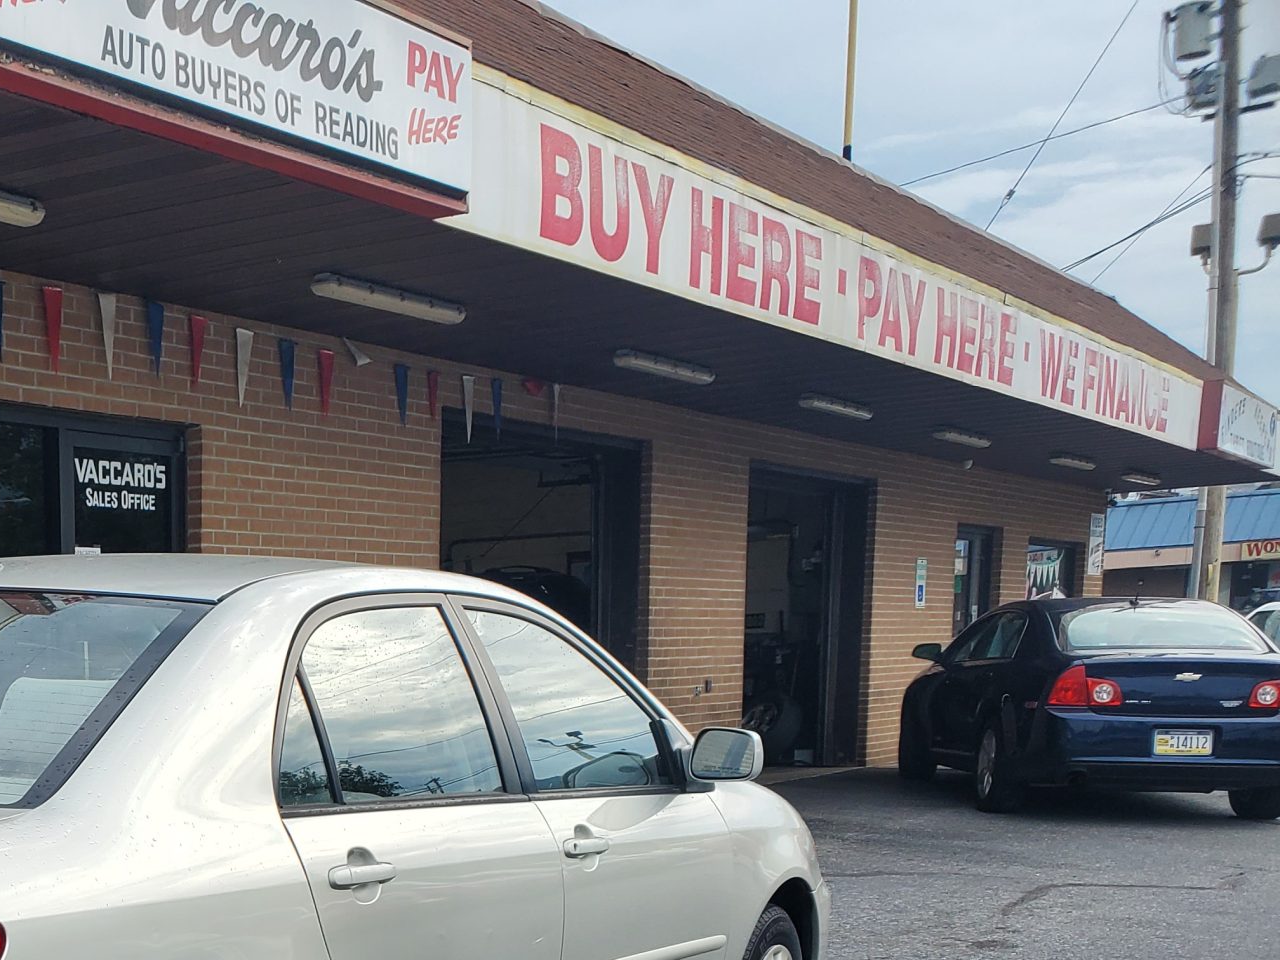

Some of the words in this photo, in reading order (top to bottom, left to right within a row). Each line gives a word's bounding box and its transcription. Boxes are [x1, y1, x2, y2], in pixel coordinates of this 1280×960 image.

[101, 25, 166, 81] AUTO
[175, 50, 266, 116] BUYERS
[275, 88, 302, 126] OF
[315, 101, 399, 160] READING
[407, 40, 464, 103] PAY
[408, 107, 462, 145] HERE
[539, 123, 675, 275] BUY
[689, 186, 823, 326] HERE
[857, 255, 926, 356] PAY
[933, 286, 1017, 386] HERE
[1040, 328, 1079, 406] WE
[1081, 346, 1170, 432] FINANCE
[74, 458, 166, 490] VACCARO'S
[85, 488, 118, 509] SALES
[121, 490, 156, 511] OFFICE
